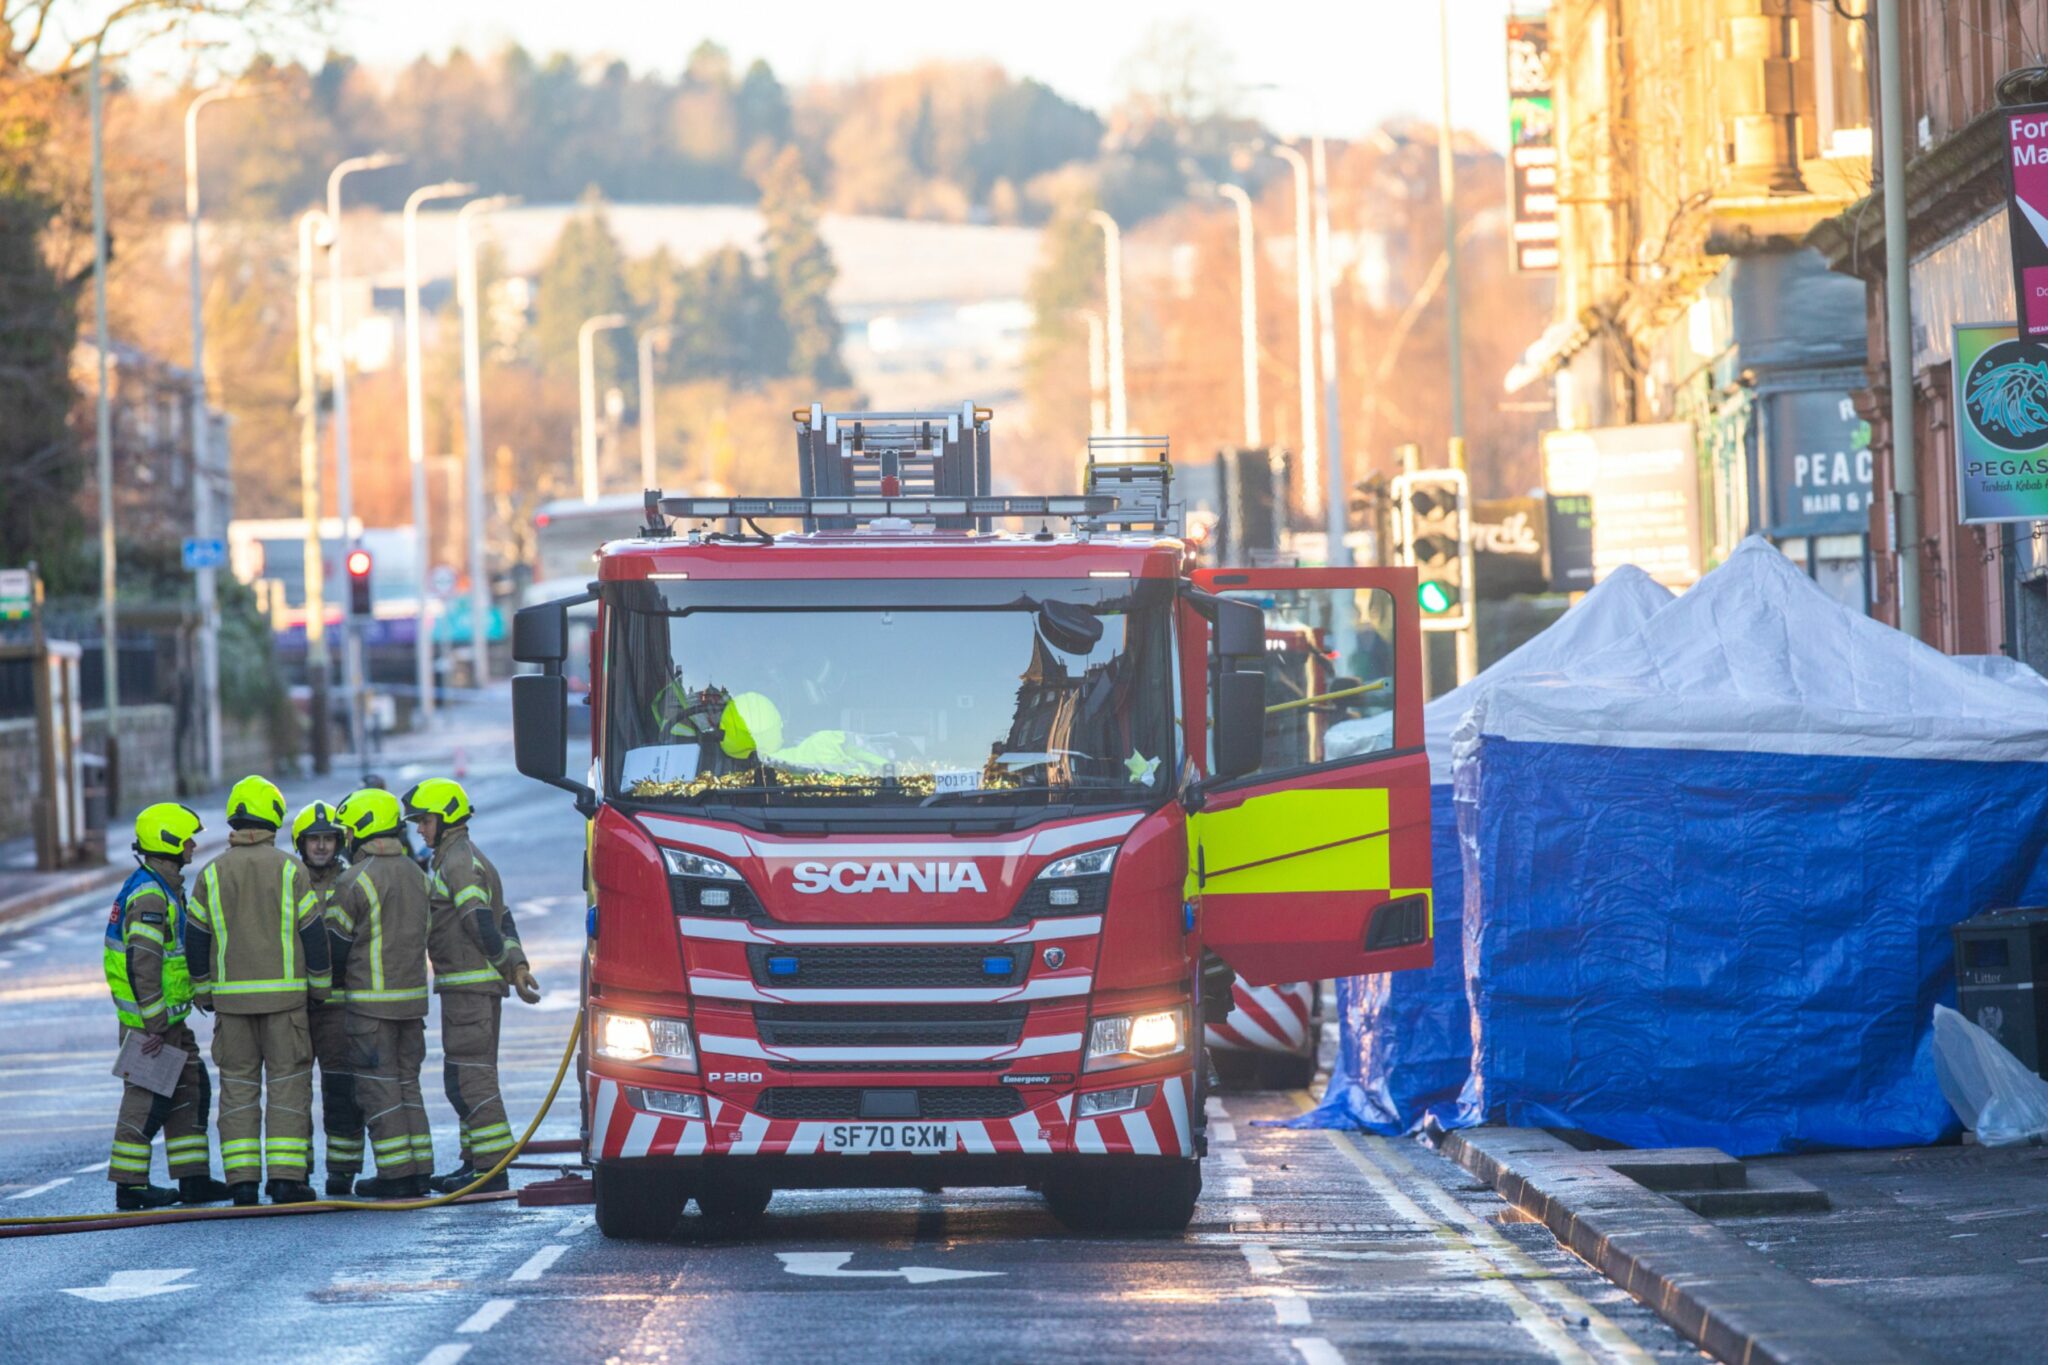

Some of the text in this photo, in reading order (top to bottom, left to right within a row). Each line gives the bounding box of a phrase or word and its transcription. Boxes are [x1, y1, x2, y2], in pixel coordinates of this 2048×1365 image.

[2013, 144, 2048, 167] Ma
[1794, 449, 1873, 488] PEAC
[1966, 458, 2048, 477] PEGAS
[1981, 480, 2012, 493] Turkish
[2015, 479, 2042, 492] Kebab
[792, 861, 988, 894] SCANIA
[1974, 972, 2002, 984] Litter
[708, 1072, 763, 1084] P 280
[1003, 1075, 1051, 1084] Emergency
[833, 1126, 947, 1147] SF70 GXW
